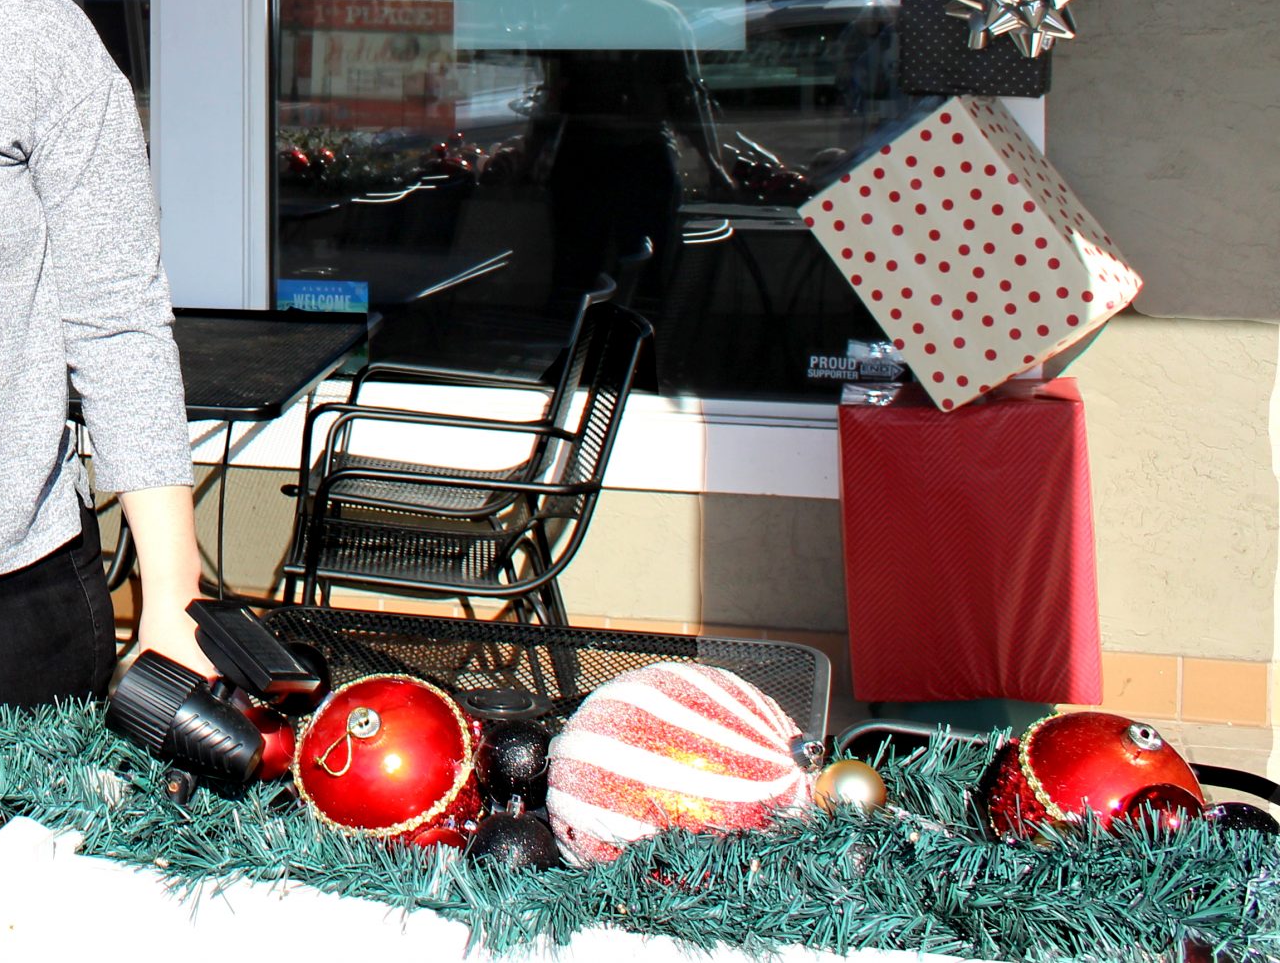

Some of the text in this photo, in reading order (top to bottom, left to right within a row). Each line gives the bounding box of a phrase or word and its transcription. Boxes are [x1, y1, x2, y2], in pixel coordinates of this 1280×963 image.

[293, 293, 352, 310] WELCOME
[810, 355, 856, 371] PROUD
[807, 368, 859, 380] SUPPORTER
